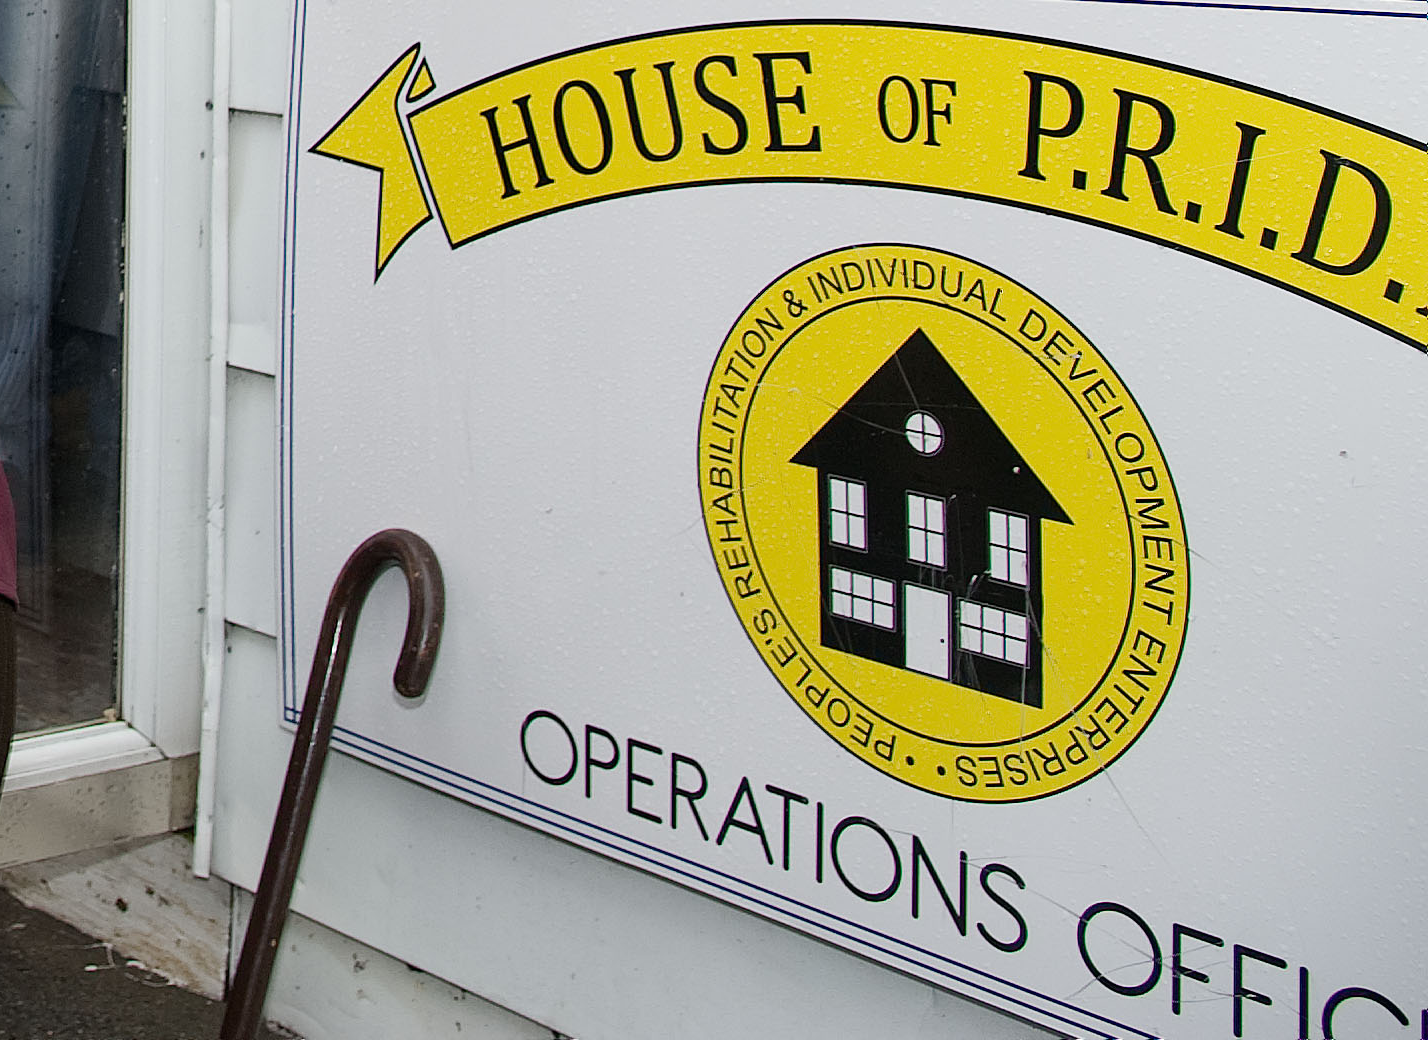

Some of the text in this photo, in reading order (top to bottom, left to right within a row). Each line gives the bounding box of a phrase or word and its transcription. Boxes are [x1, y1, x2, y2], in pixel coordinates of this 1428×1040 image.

[480, 50, 1428, 318] HOUSE OF P.R.I.D.
[708, 258, 1175, 789] PEOPLE'S REHABILITATION & INDIVIDUAL DEVELOPMENT ENTERPRISES
[520, 709, 1428, 1040] OPERATIONS OFFIC
